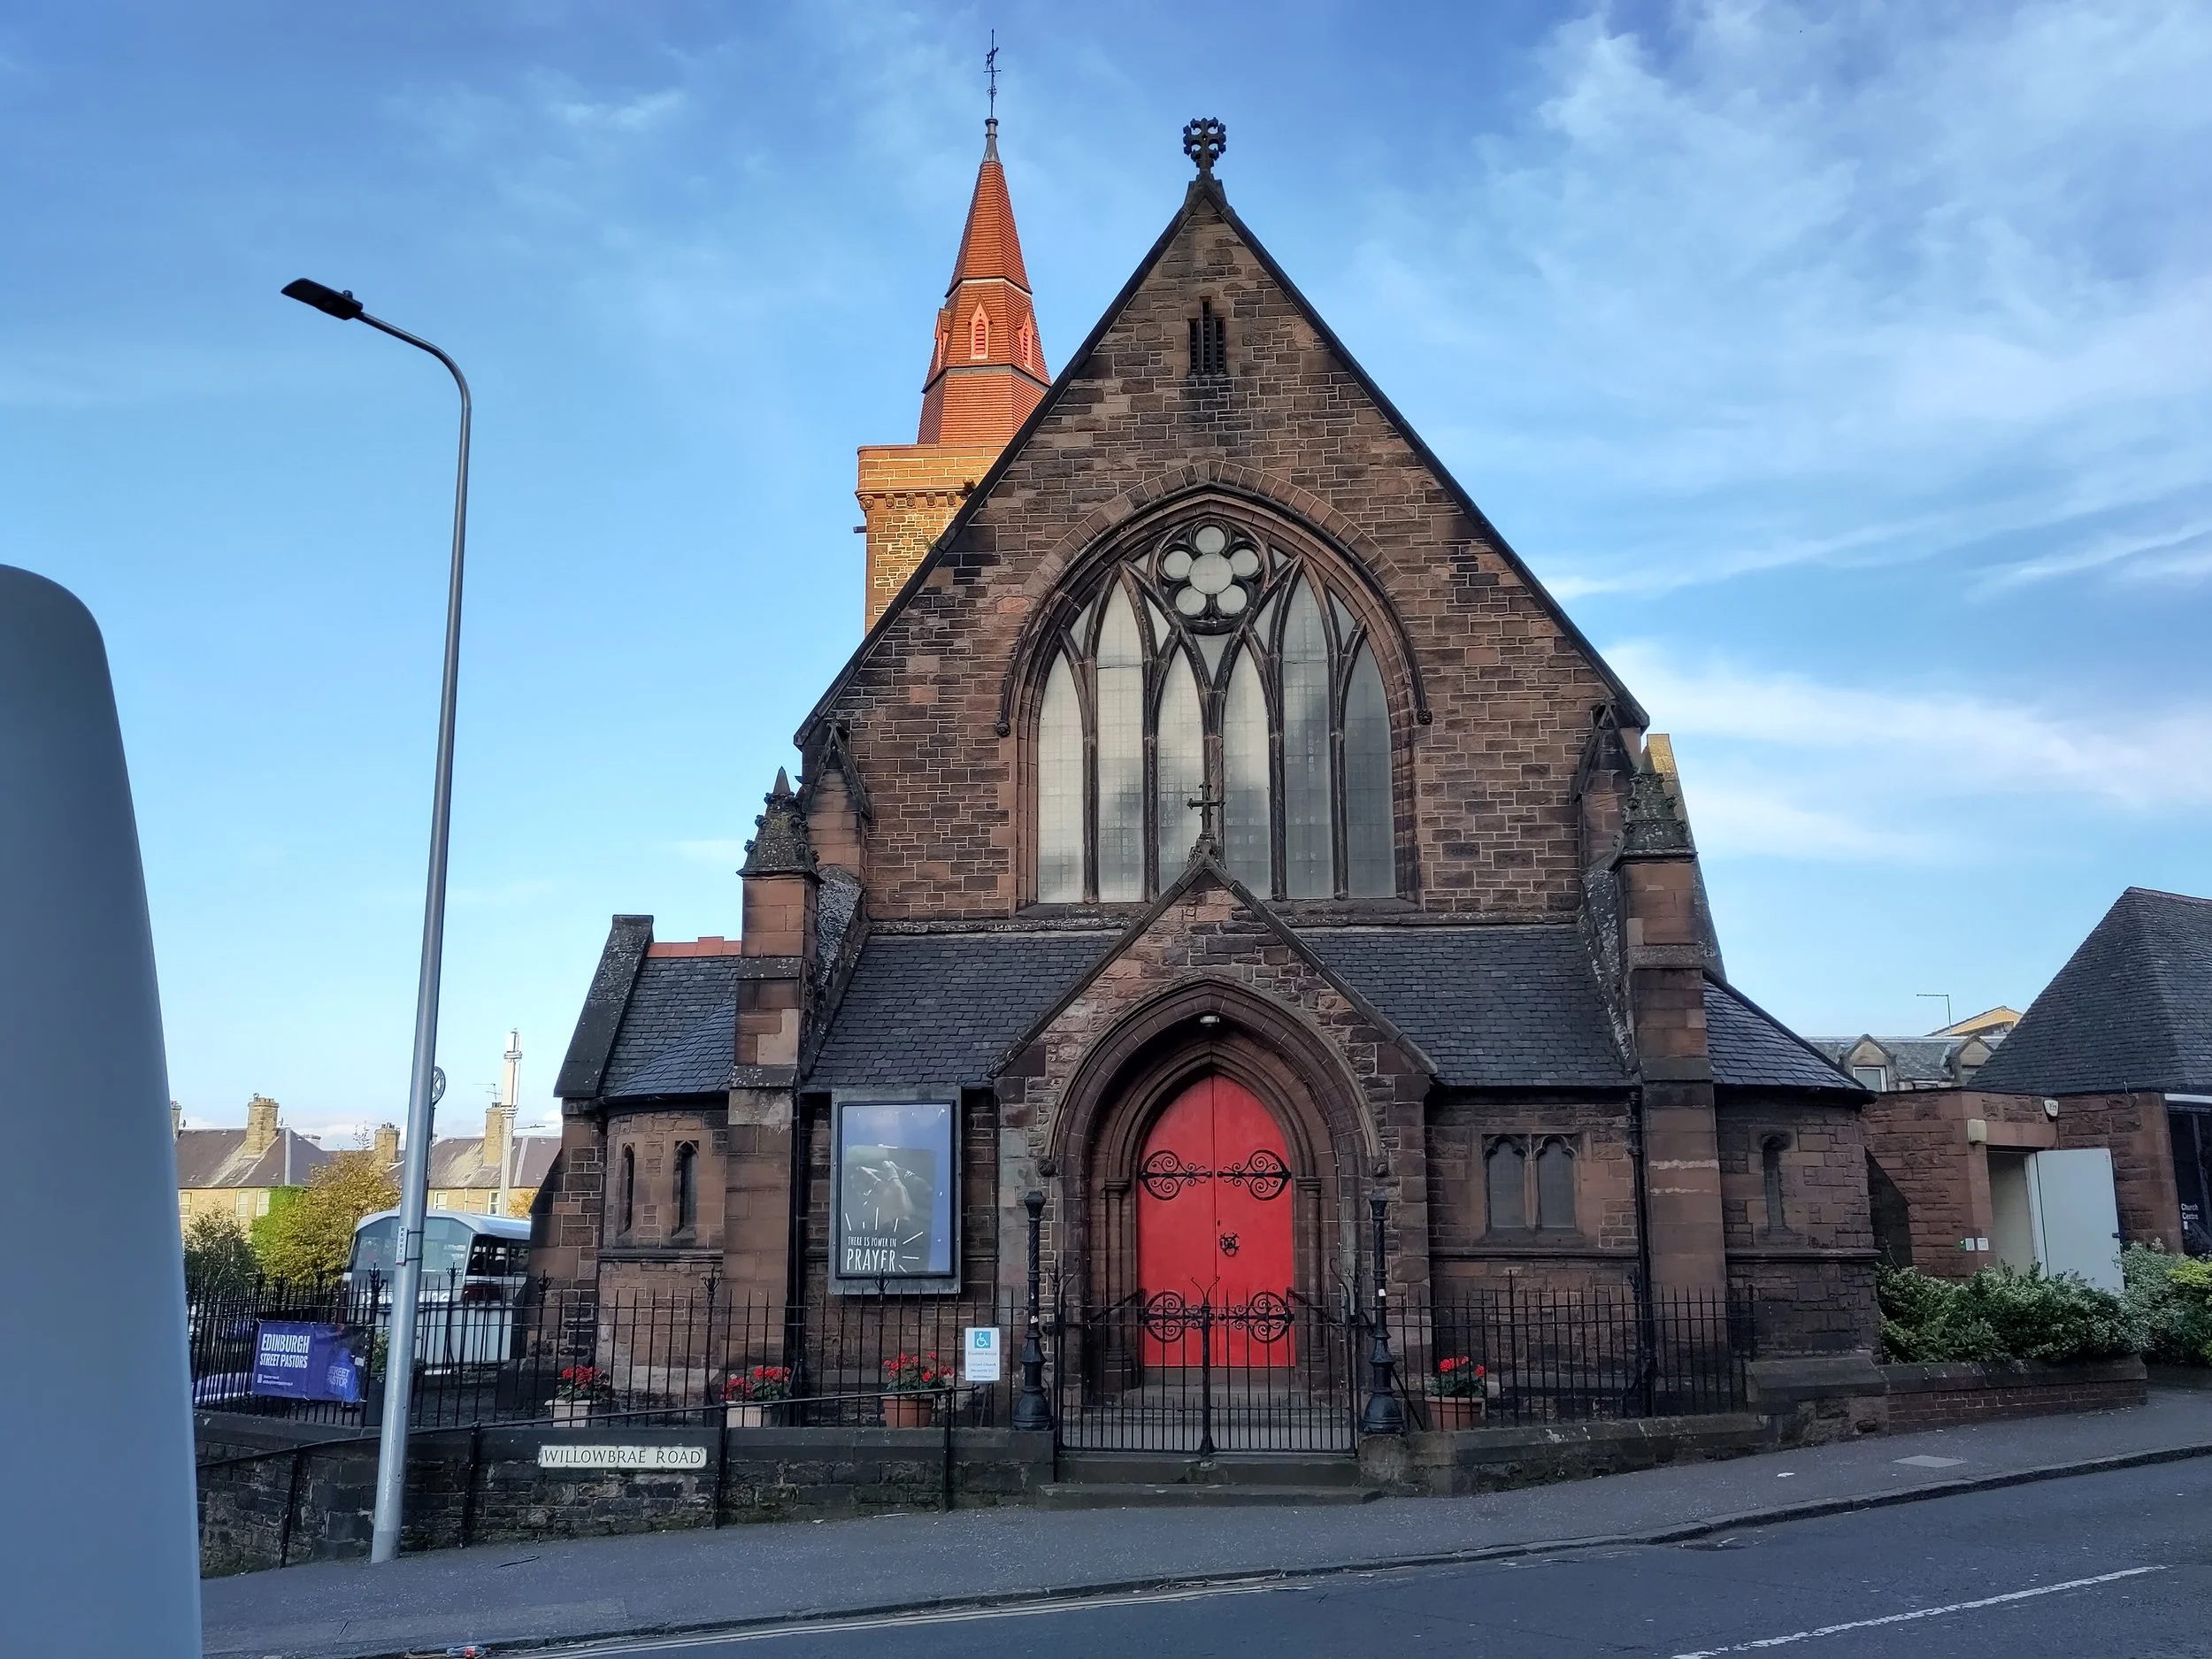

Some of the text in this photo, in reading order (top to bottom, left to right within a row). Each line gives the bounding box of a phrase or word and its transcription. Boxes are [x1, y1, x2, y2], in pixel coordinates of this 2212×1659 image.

[848, 1236, 897, 1248] THERE IS POWER IN
[847, 1248, 895, 1271] PRAYER
[261, 1333, 311, 1353] EDINBURGH
[259, 1353, 308, 1368] STREET PASTORS
[328, 1365, 350, 1378] STREET
[544, 1449, 702, 1464] WILLOWBRAE ROAD
